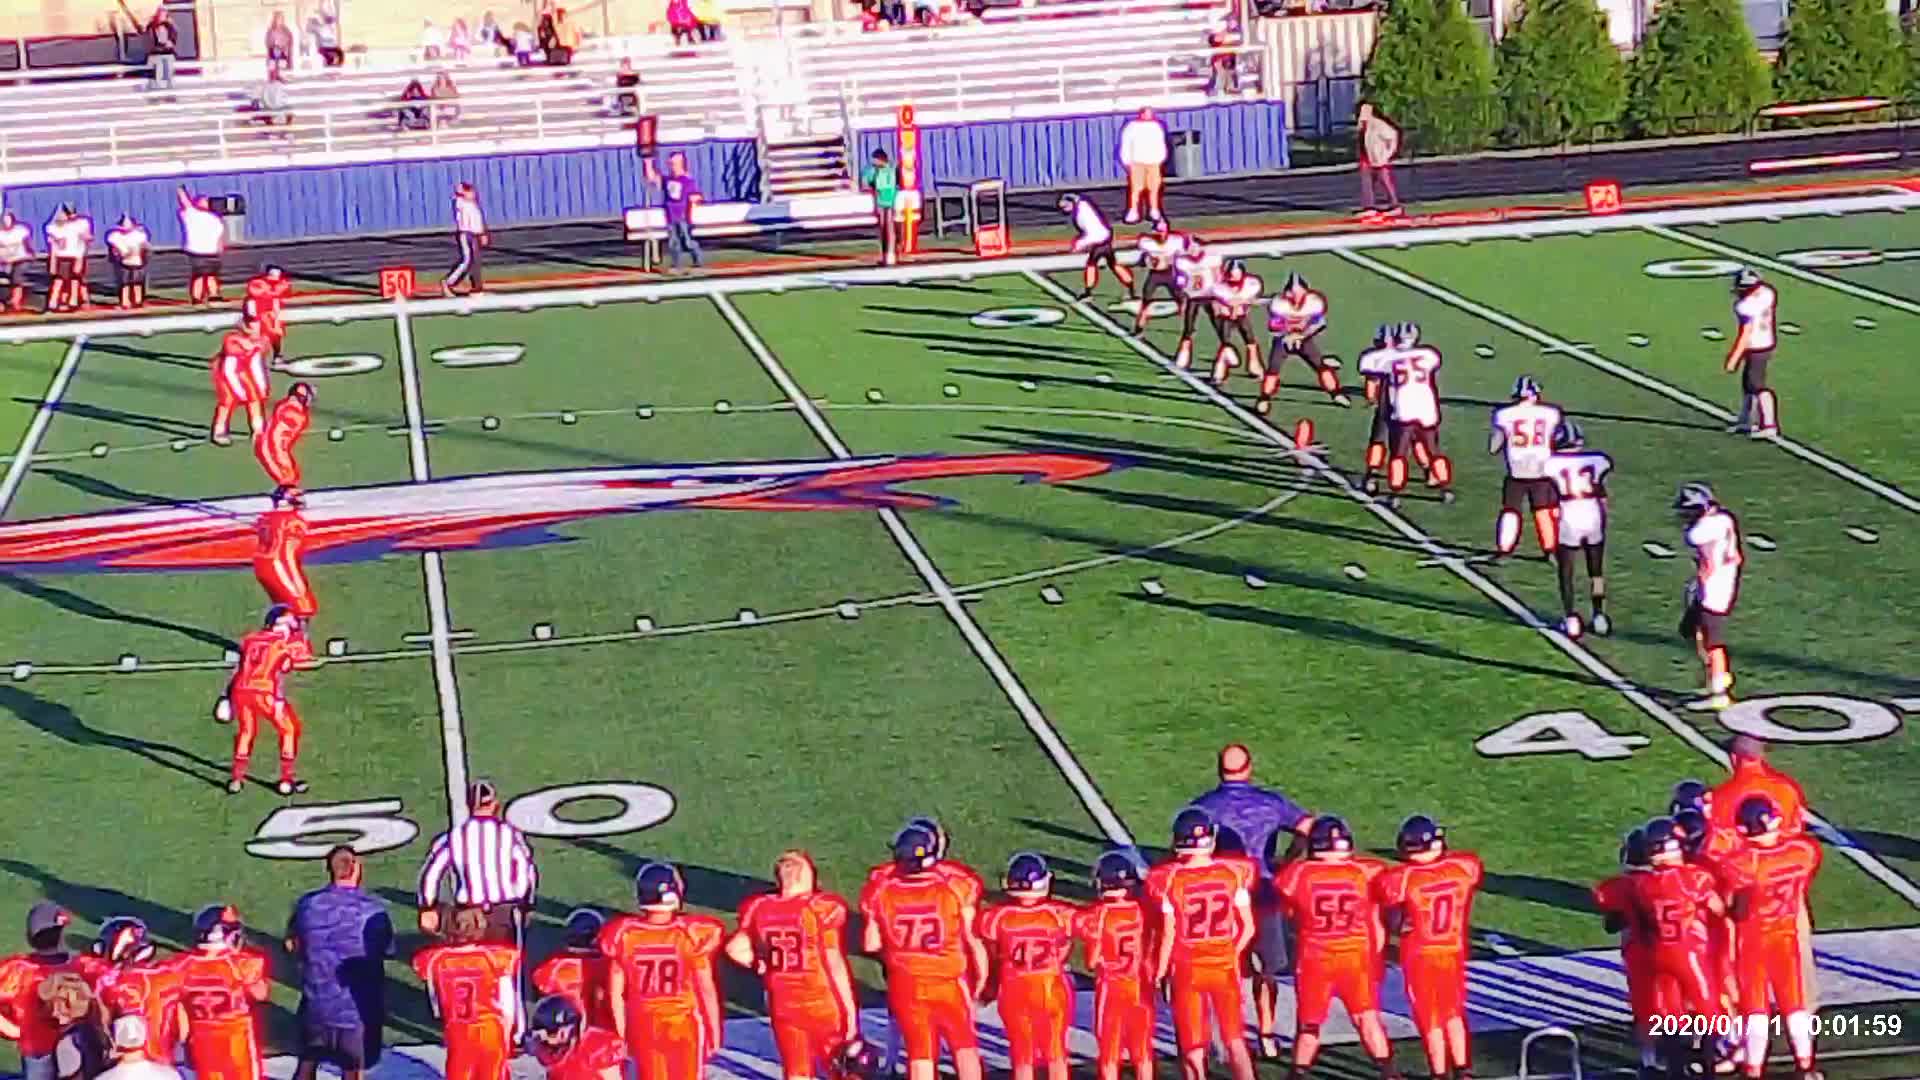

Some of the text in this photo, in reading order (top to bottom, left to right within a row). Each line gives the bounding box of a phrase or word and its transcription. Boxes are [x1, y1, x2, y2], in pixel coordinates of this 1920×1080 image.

[1392, 356, 1428, 386] 65
[1511, 418, 1546, 448] 58
[1186, 895, 1230, 937] 22
[1312, 895, 1357, 930] 55
[767, 931, 801, 971] 63
[893, 918, 939, 953] 72
[1011, 937, 1052, 970] 42
[636, 959, 678, 994] 78
